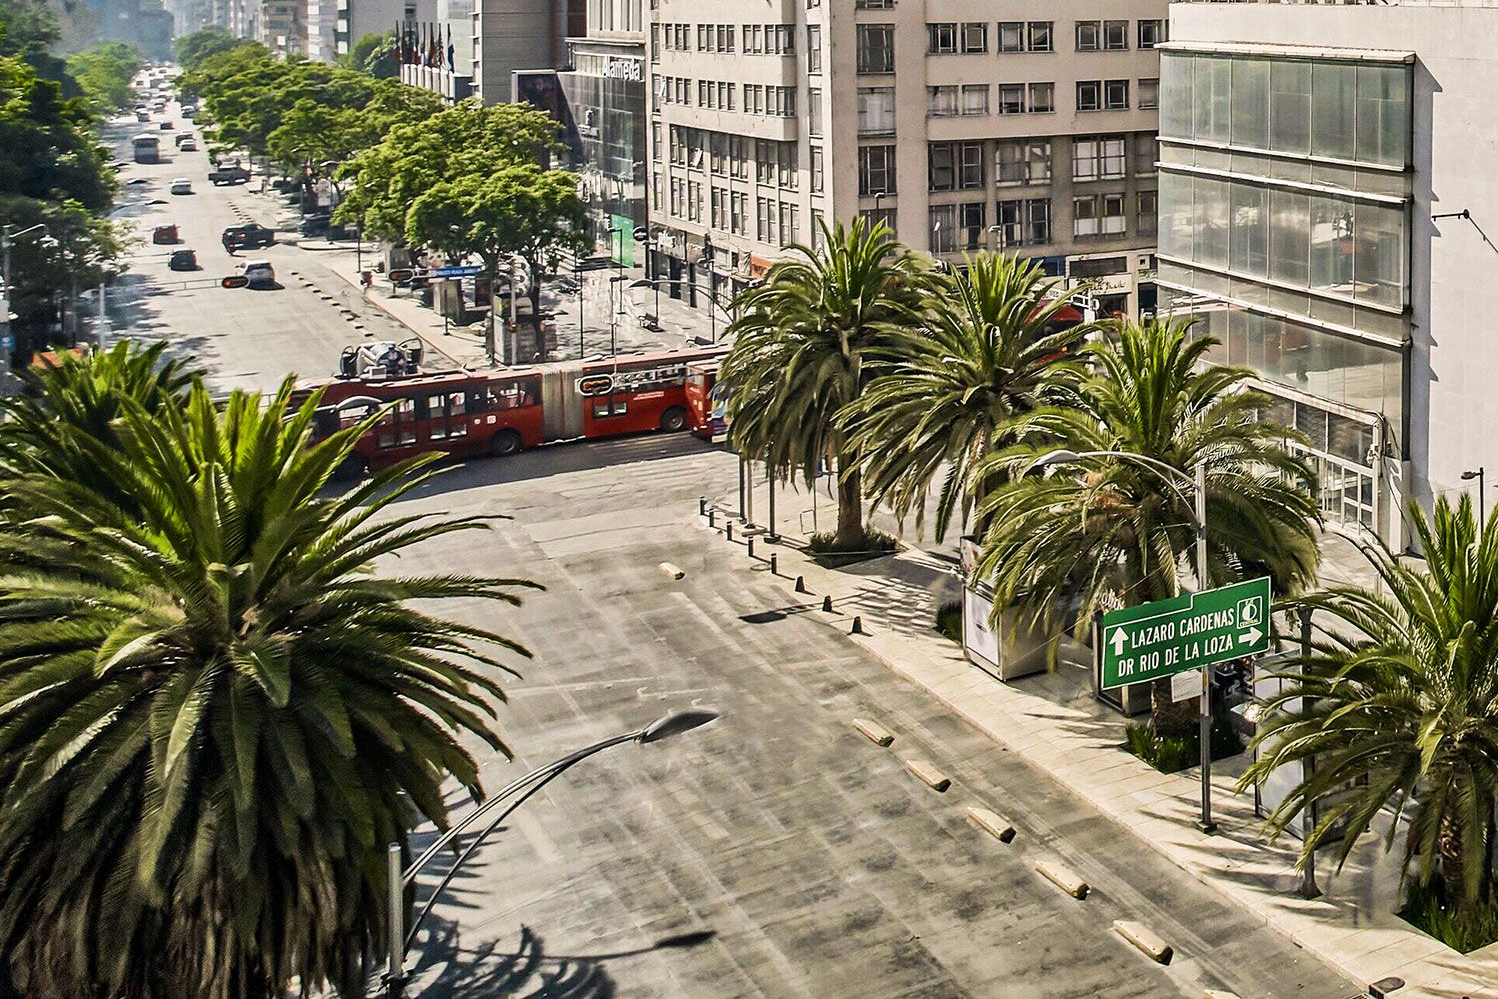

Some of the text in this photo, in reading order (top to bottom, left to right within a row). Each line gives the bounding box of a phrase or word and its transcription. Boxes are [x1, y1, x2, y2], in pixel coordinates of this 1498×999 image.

[602, 55, 640, 81] Alameda
[1132, 608, 1234, 649] LAZARO CARDENAS
[1118, 634, 1234, 677] DR RIO DE LA LOZA
